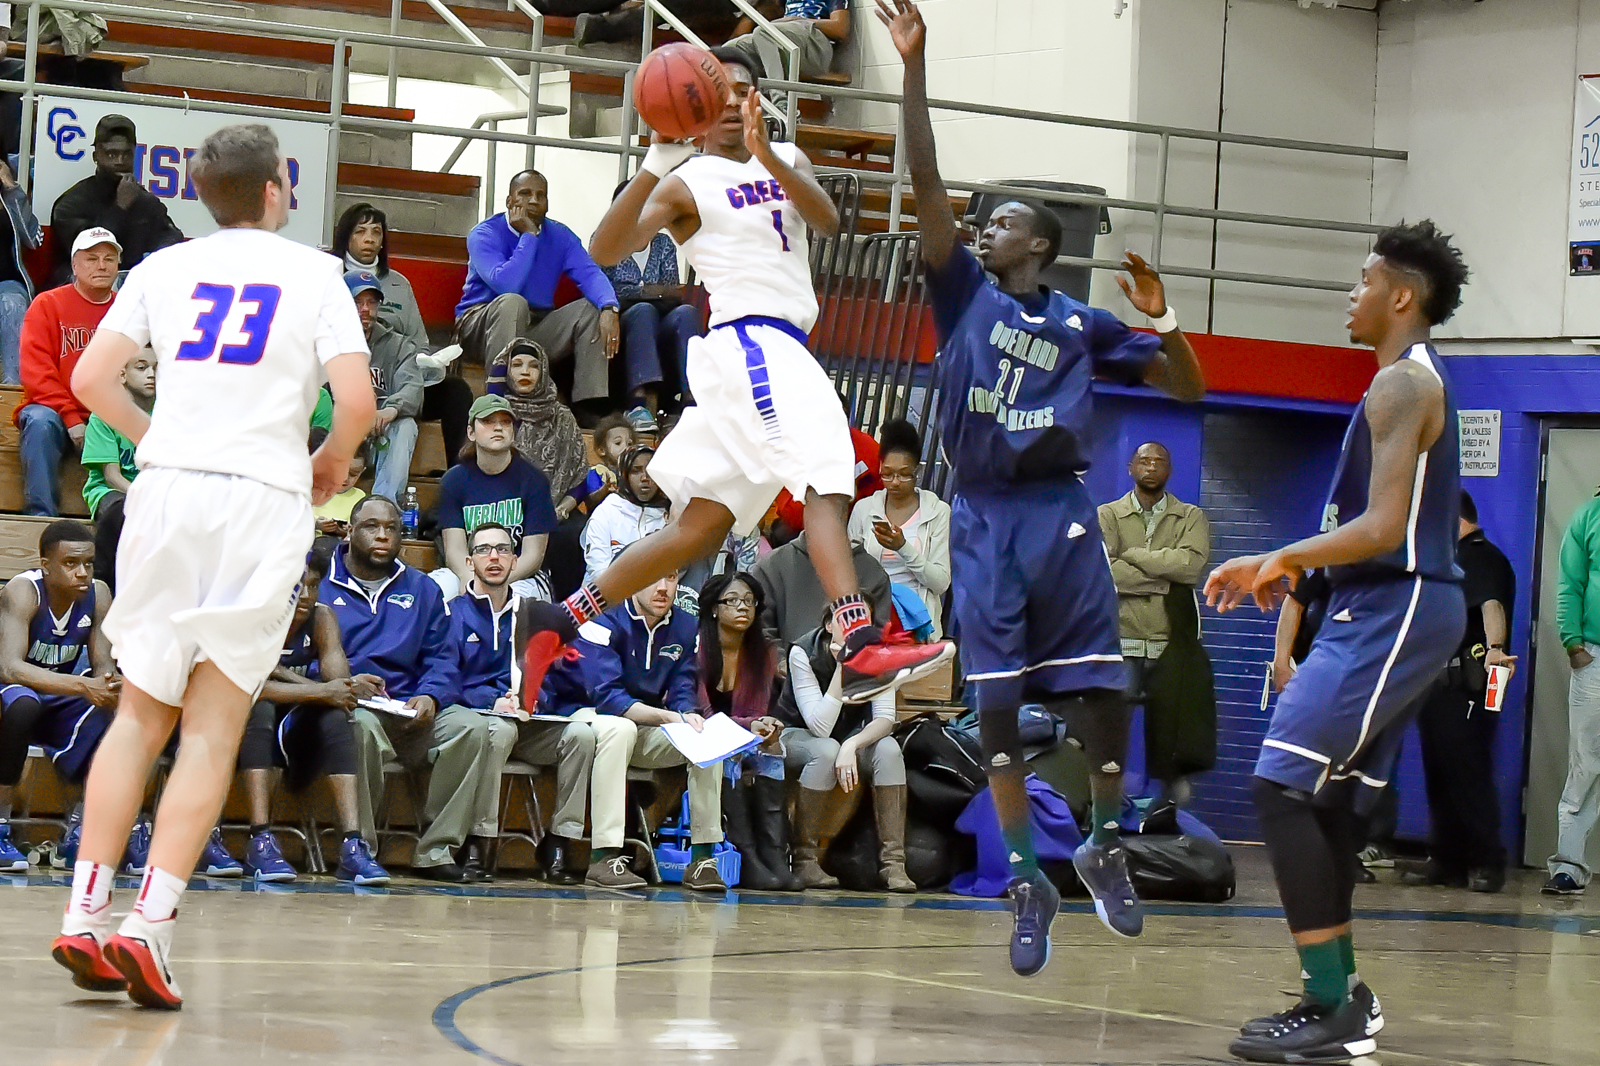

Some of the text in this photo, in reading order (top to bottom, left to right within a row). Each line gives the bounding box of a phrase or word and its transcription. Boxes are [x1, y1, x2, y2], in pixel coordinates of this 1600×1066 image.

[725, 179, 792, 210] CREE
[771, 209, 791, 252] 1
[174, 281, 282, 366] 33
[998, 358, 1025, 405] 21
